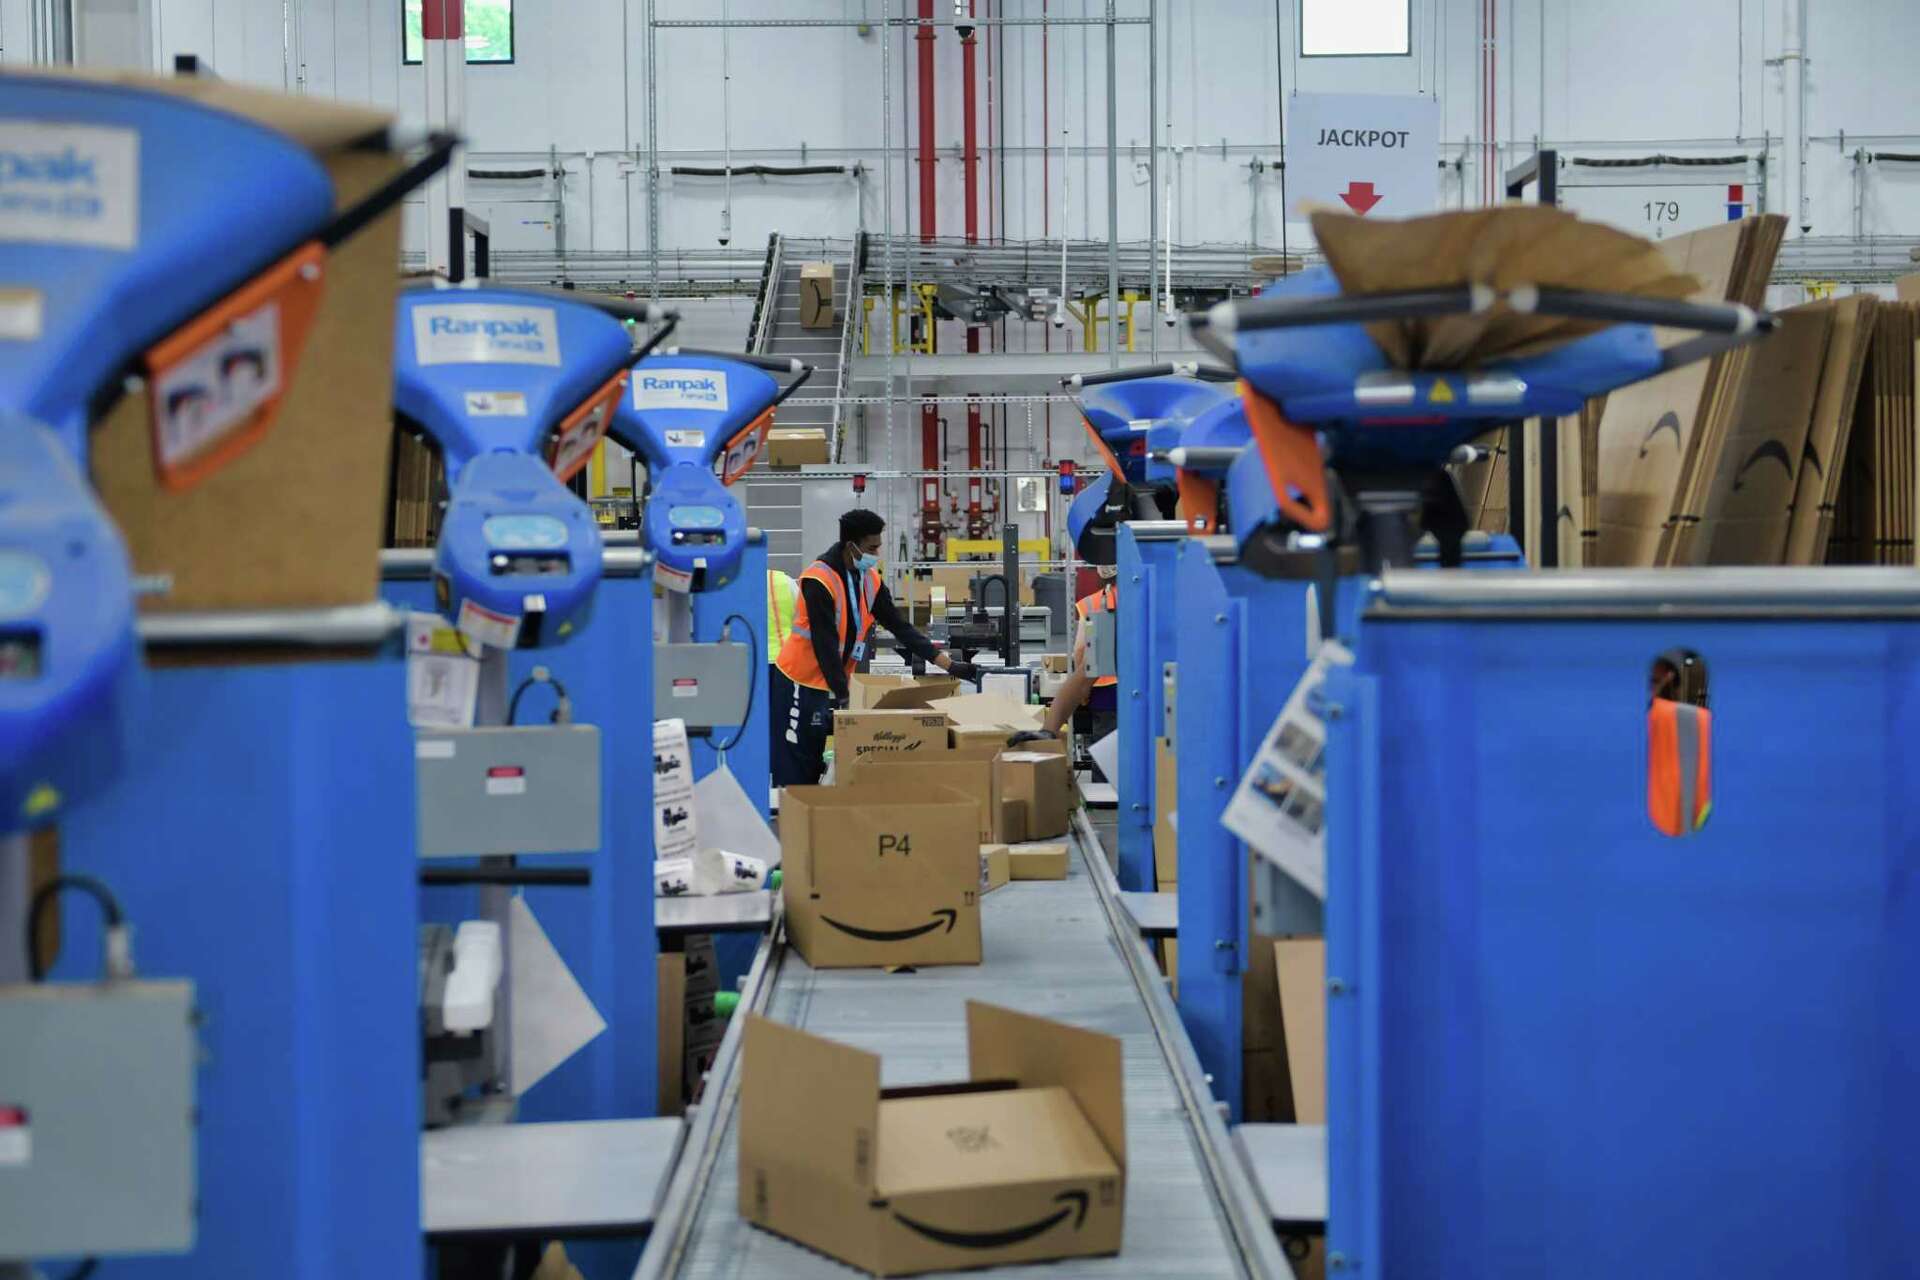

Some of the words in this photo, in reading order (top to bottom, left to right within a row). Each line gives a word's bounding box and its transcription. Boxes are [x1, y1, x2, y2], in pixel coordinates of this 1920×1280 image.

[1317, 128, 1411, 149] JACKPOT
[1643, 201, 1680, 222] 179
[430, 316, 541, 338] Ranpak
[642, 376, 717, 392] Ranpak
[879, 834, 913, 857] P4
